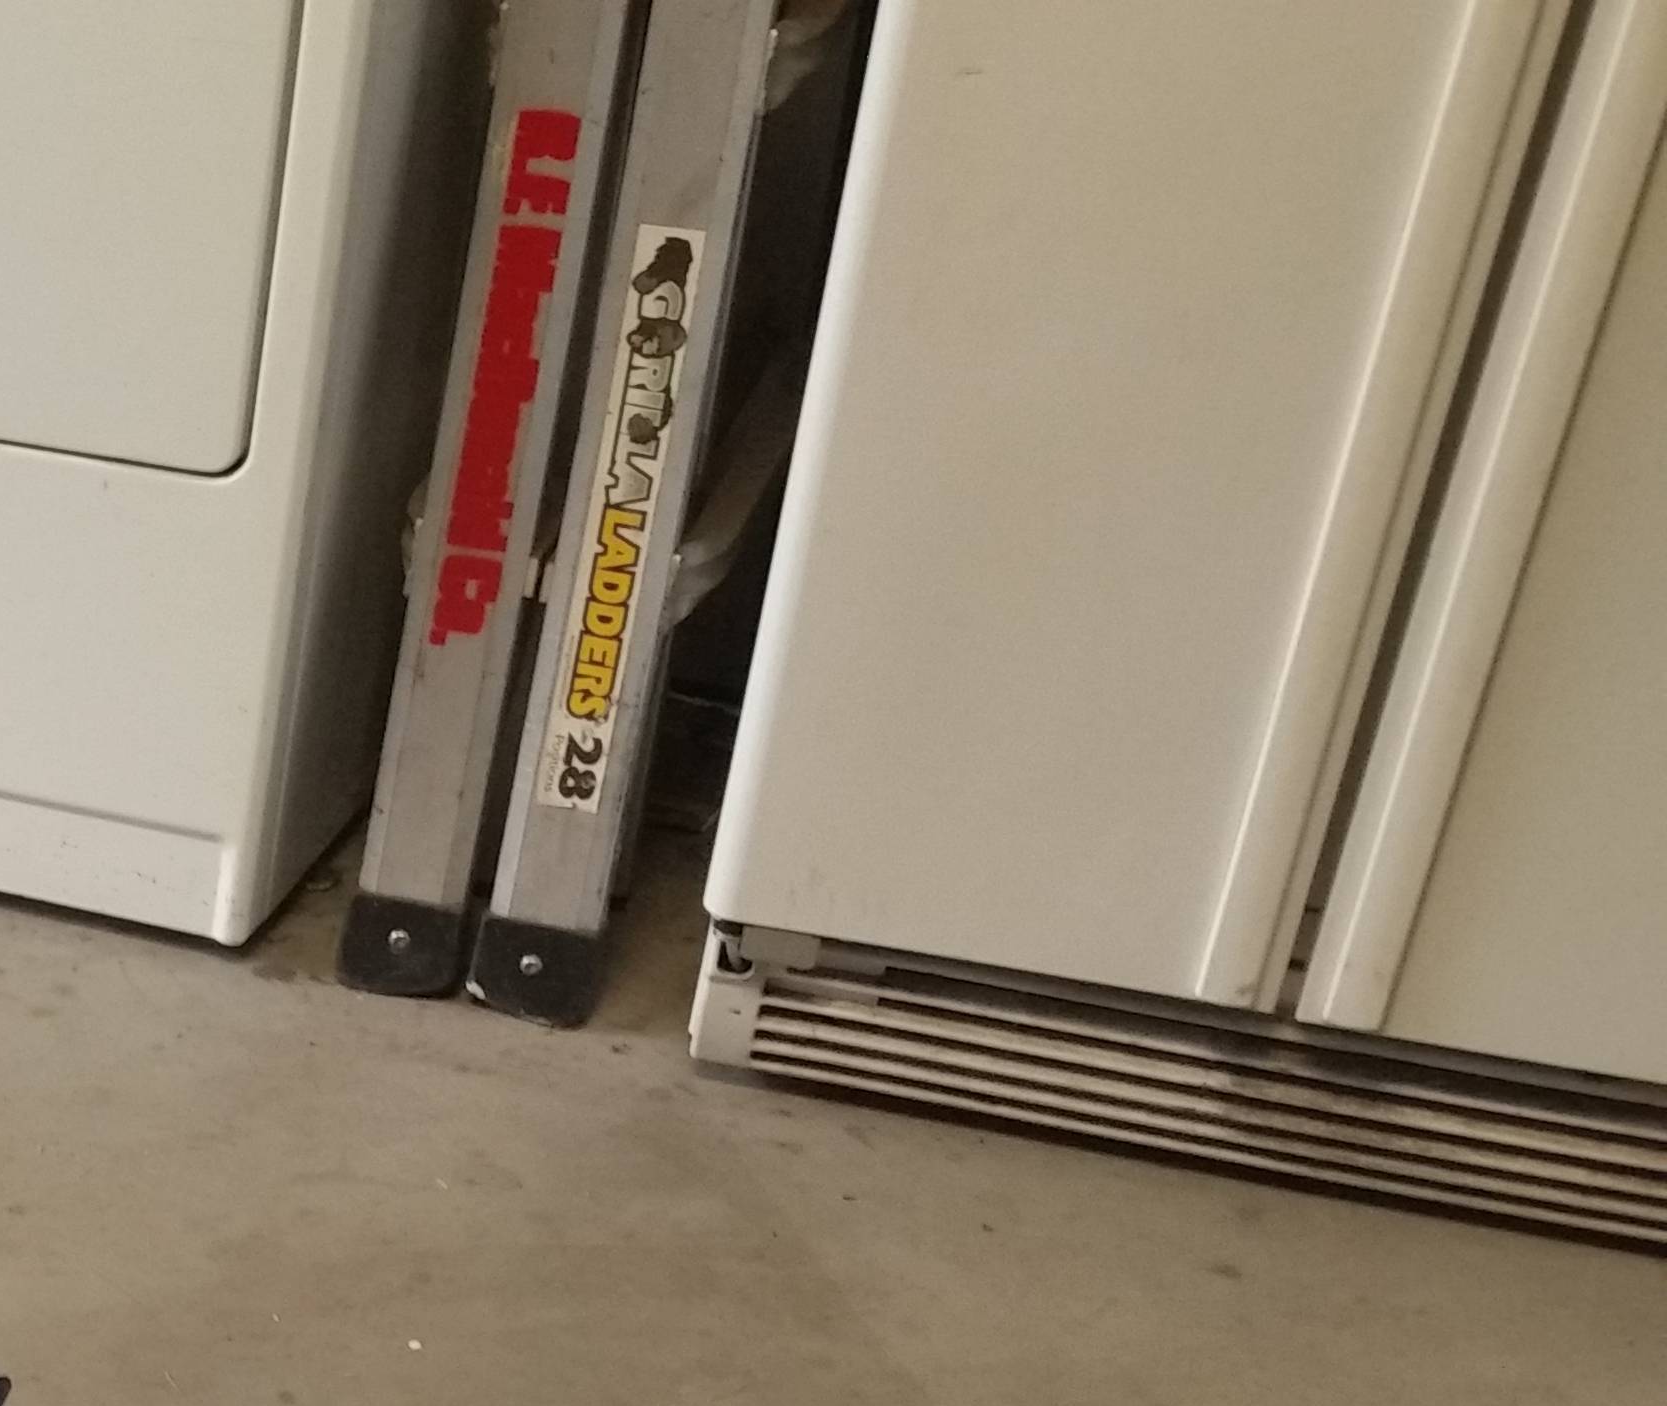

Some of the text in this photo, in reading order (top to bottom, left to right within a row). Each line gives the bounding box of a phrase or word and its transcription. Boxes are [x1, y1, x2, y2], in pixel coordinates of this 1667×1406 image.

[567, 504, 648, 722] LADDERS
[544, 734, 565, 793] Positions
[558, 731, 603, 799] 28
